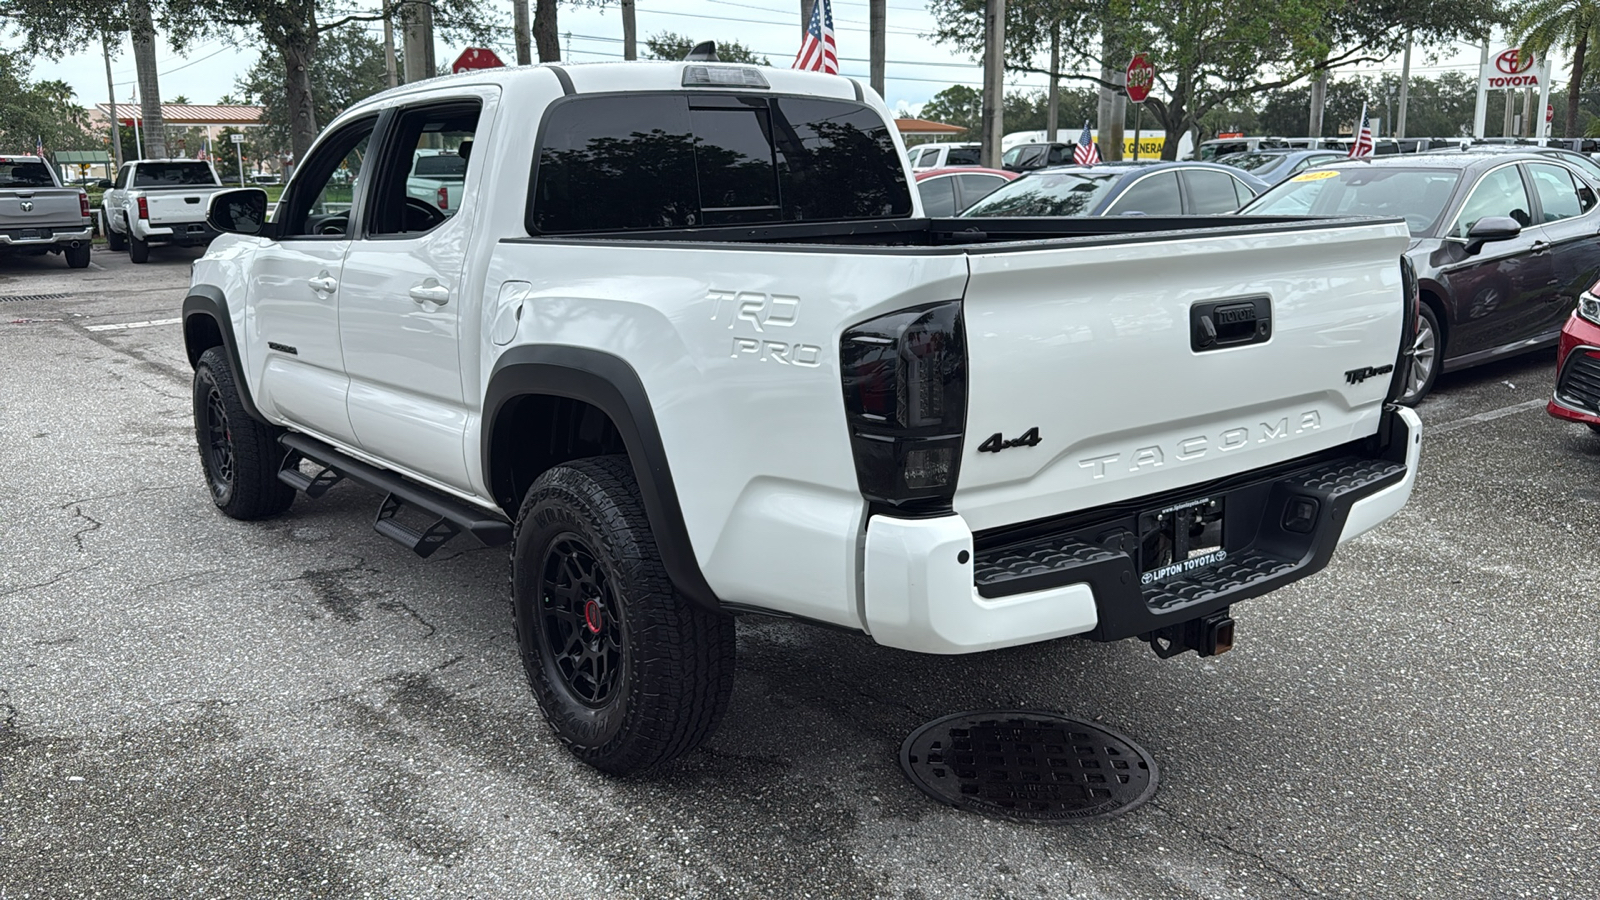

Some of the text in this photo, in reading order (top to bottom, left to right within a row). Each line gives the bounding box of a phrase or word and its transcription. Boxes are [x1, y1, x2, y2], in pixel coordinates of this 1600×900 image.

[1128, 67, 1152, 87] STOP
[1488, 75, 1538, 88] TOYOTA
[704, 289, 801, 333] TRD
[1221, 307, 1256, 322] TOYOTA
[730, 337, 822, 368] PRO
[977, 427, 1042, 453] 4x4
[1078, 409, 1321, 480] TACOMA
[1153, 554, 1215, 581] LIPTON TOYOTA
